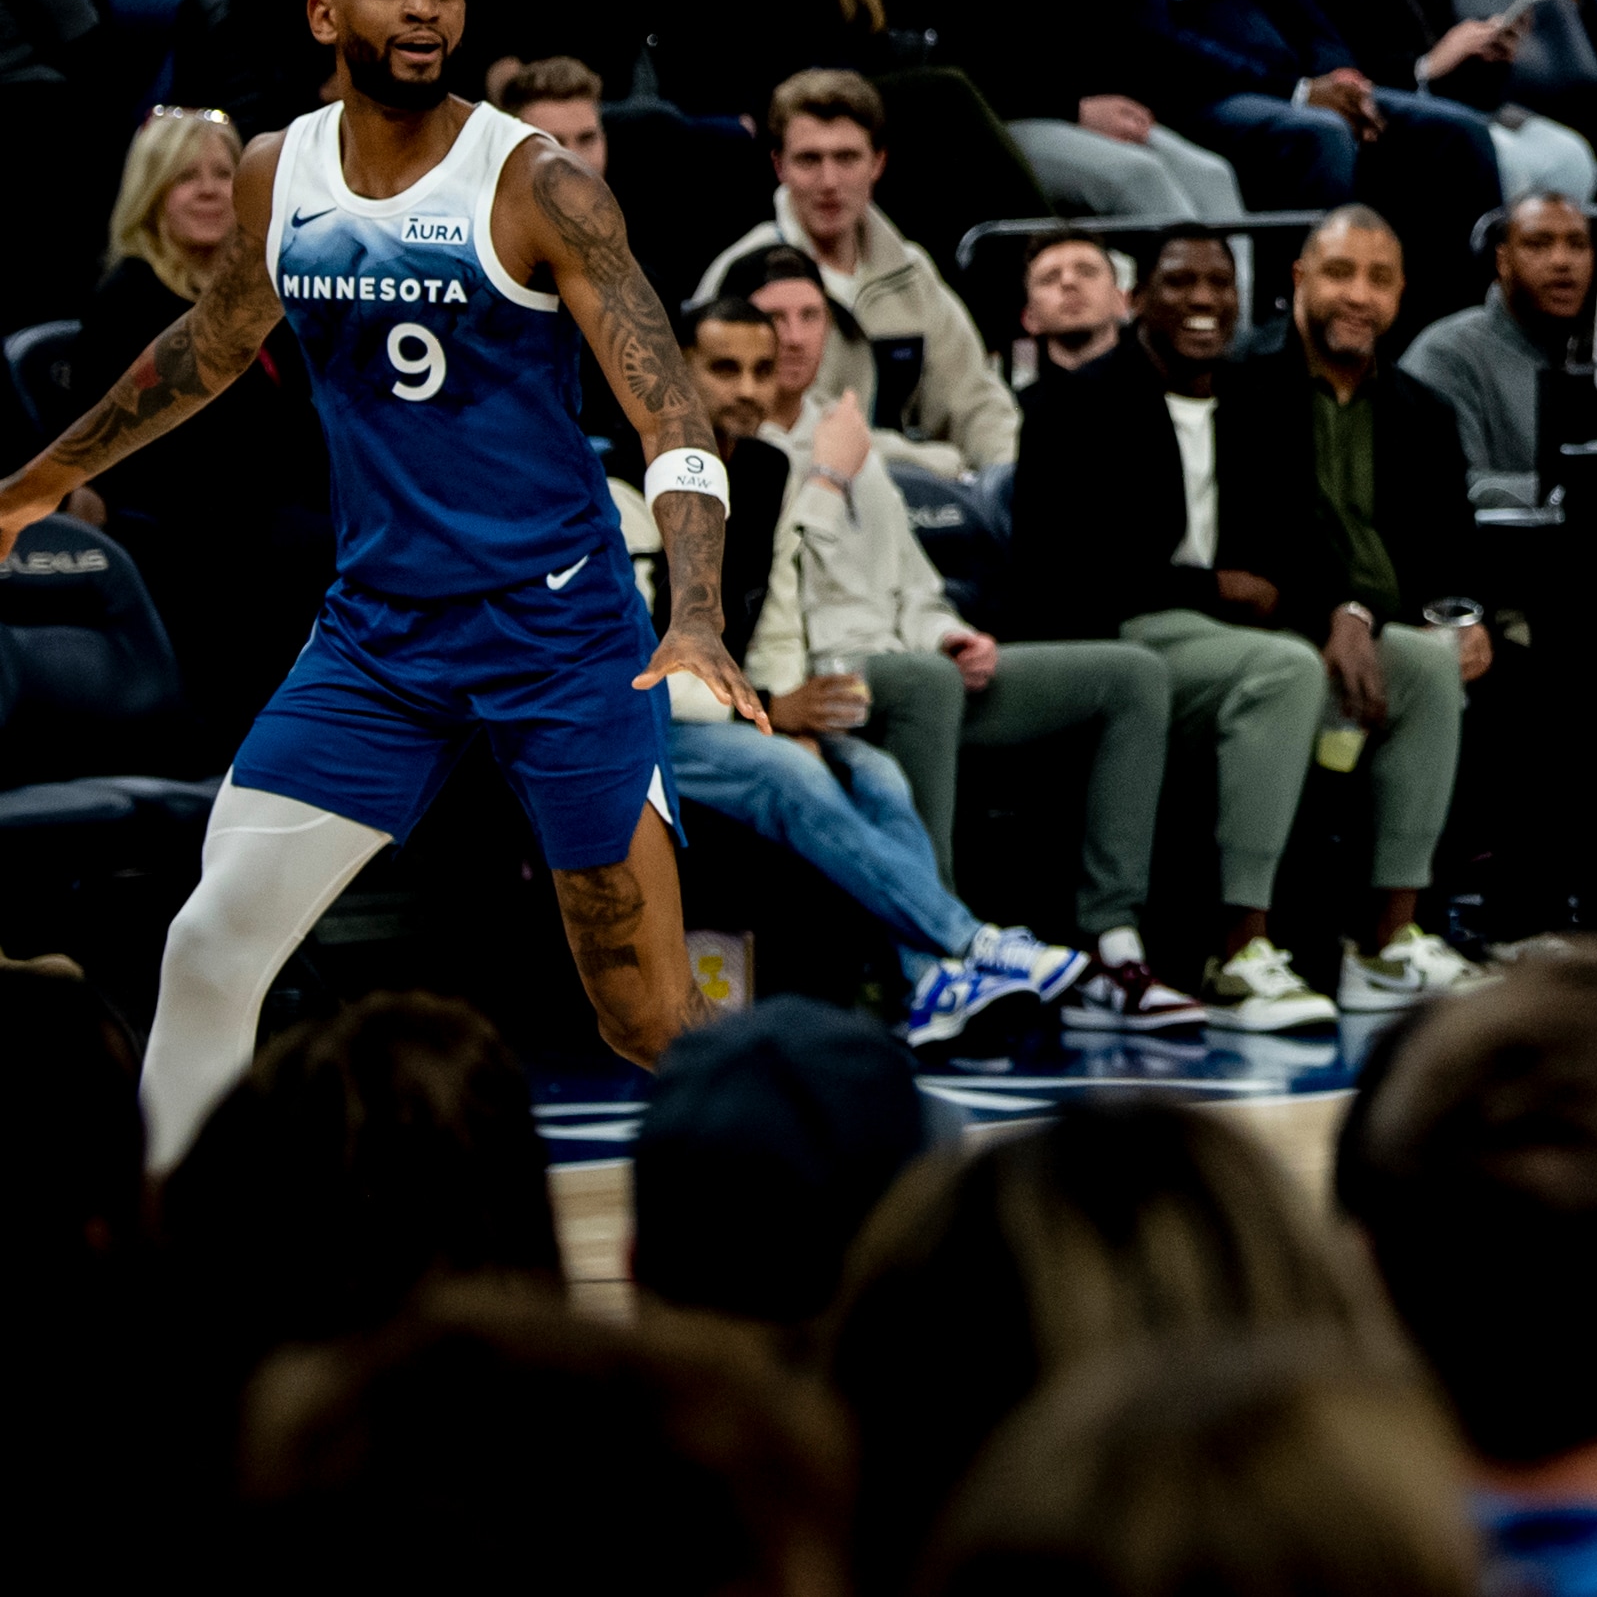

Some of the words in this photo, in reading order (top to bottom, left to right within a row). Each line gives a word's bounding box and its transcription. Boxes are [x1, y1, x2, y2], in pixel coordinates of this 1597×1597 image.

[283, 273, 469, 304] MINNESOTA
[387, 321, 447, 402] 9
[685, 454, 705, 475] 9
